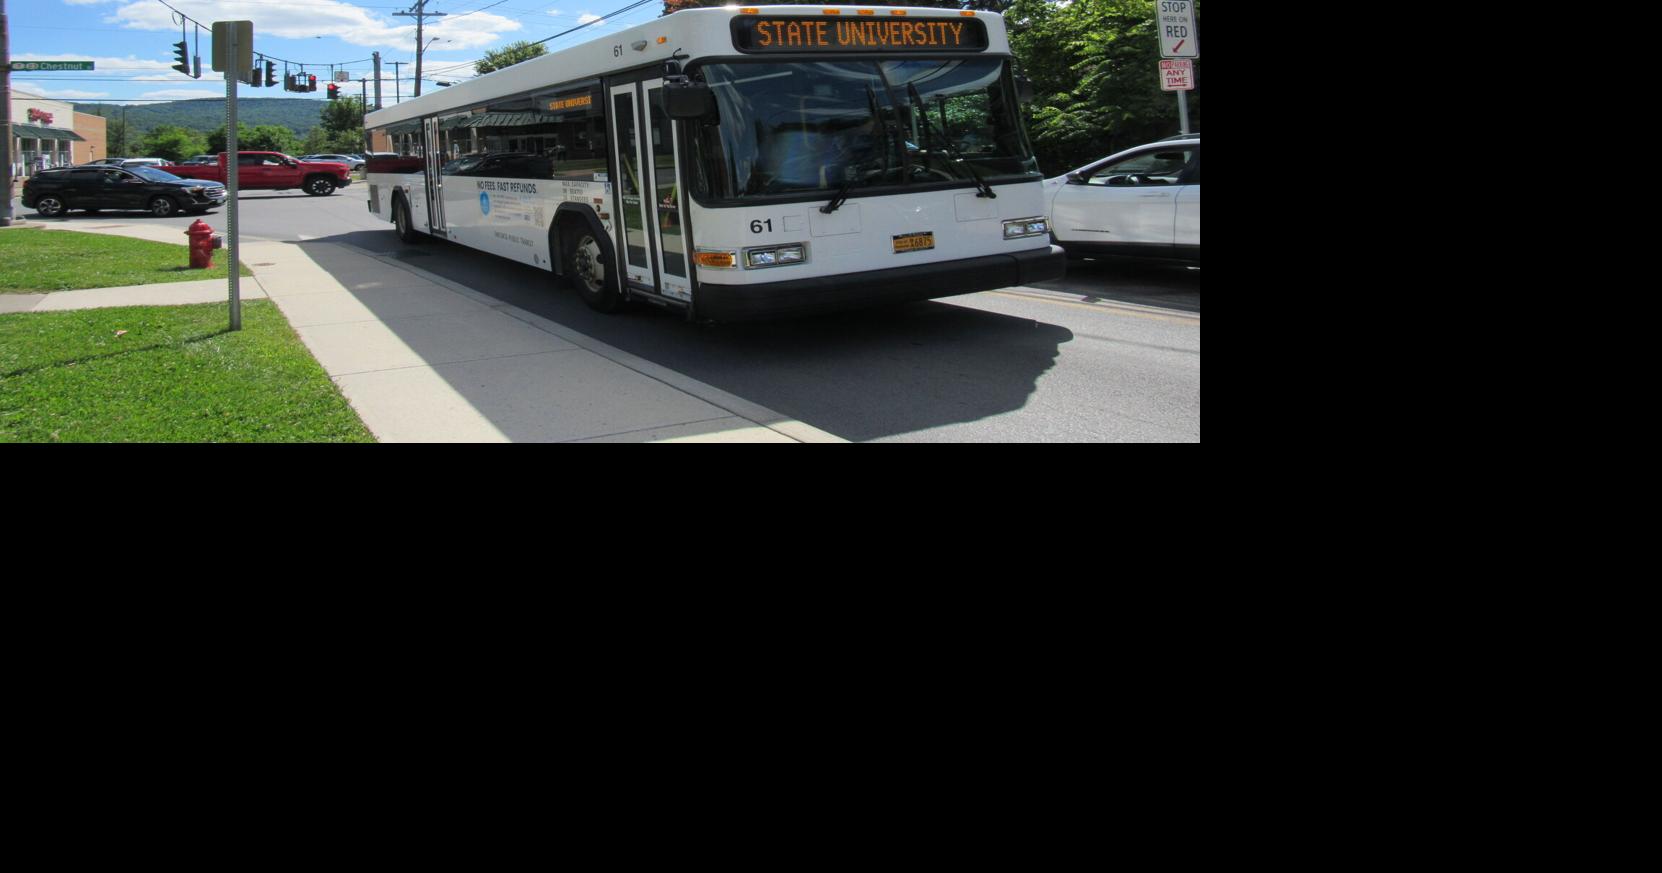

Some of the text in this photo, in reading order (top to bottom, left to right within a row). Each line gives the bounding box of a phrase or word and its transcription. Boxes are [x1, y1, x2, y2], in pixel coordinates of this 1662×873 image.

[1161, 2, 1186, 13] STOP
[757, 21, 963, 46] STATE UNIVERSITY
[1166, 26, 1188, 38] RED
[613, 45, 623, 57] 61
[40, 62, 83, 70] Chestnut
[477, 181, 485, 190] NO
[485, 181, 496, 191] FEES.
[497, 182, 510, 192] FAST
[750, 219, 773, 233] 61
